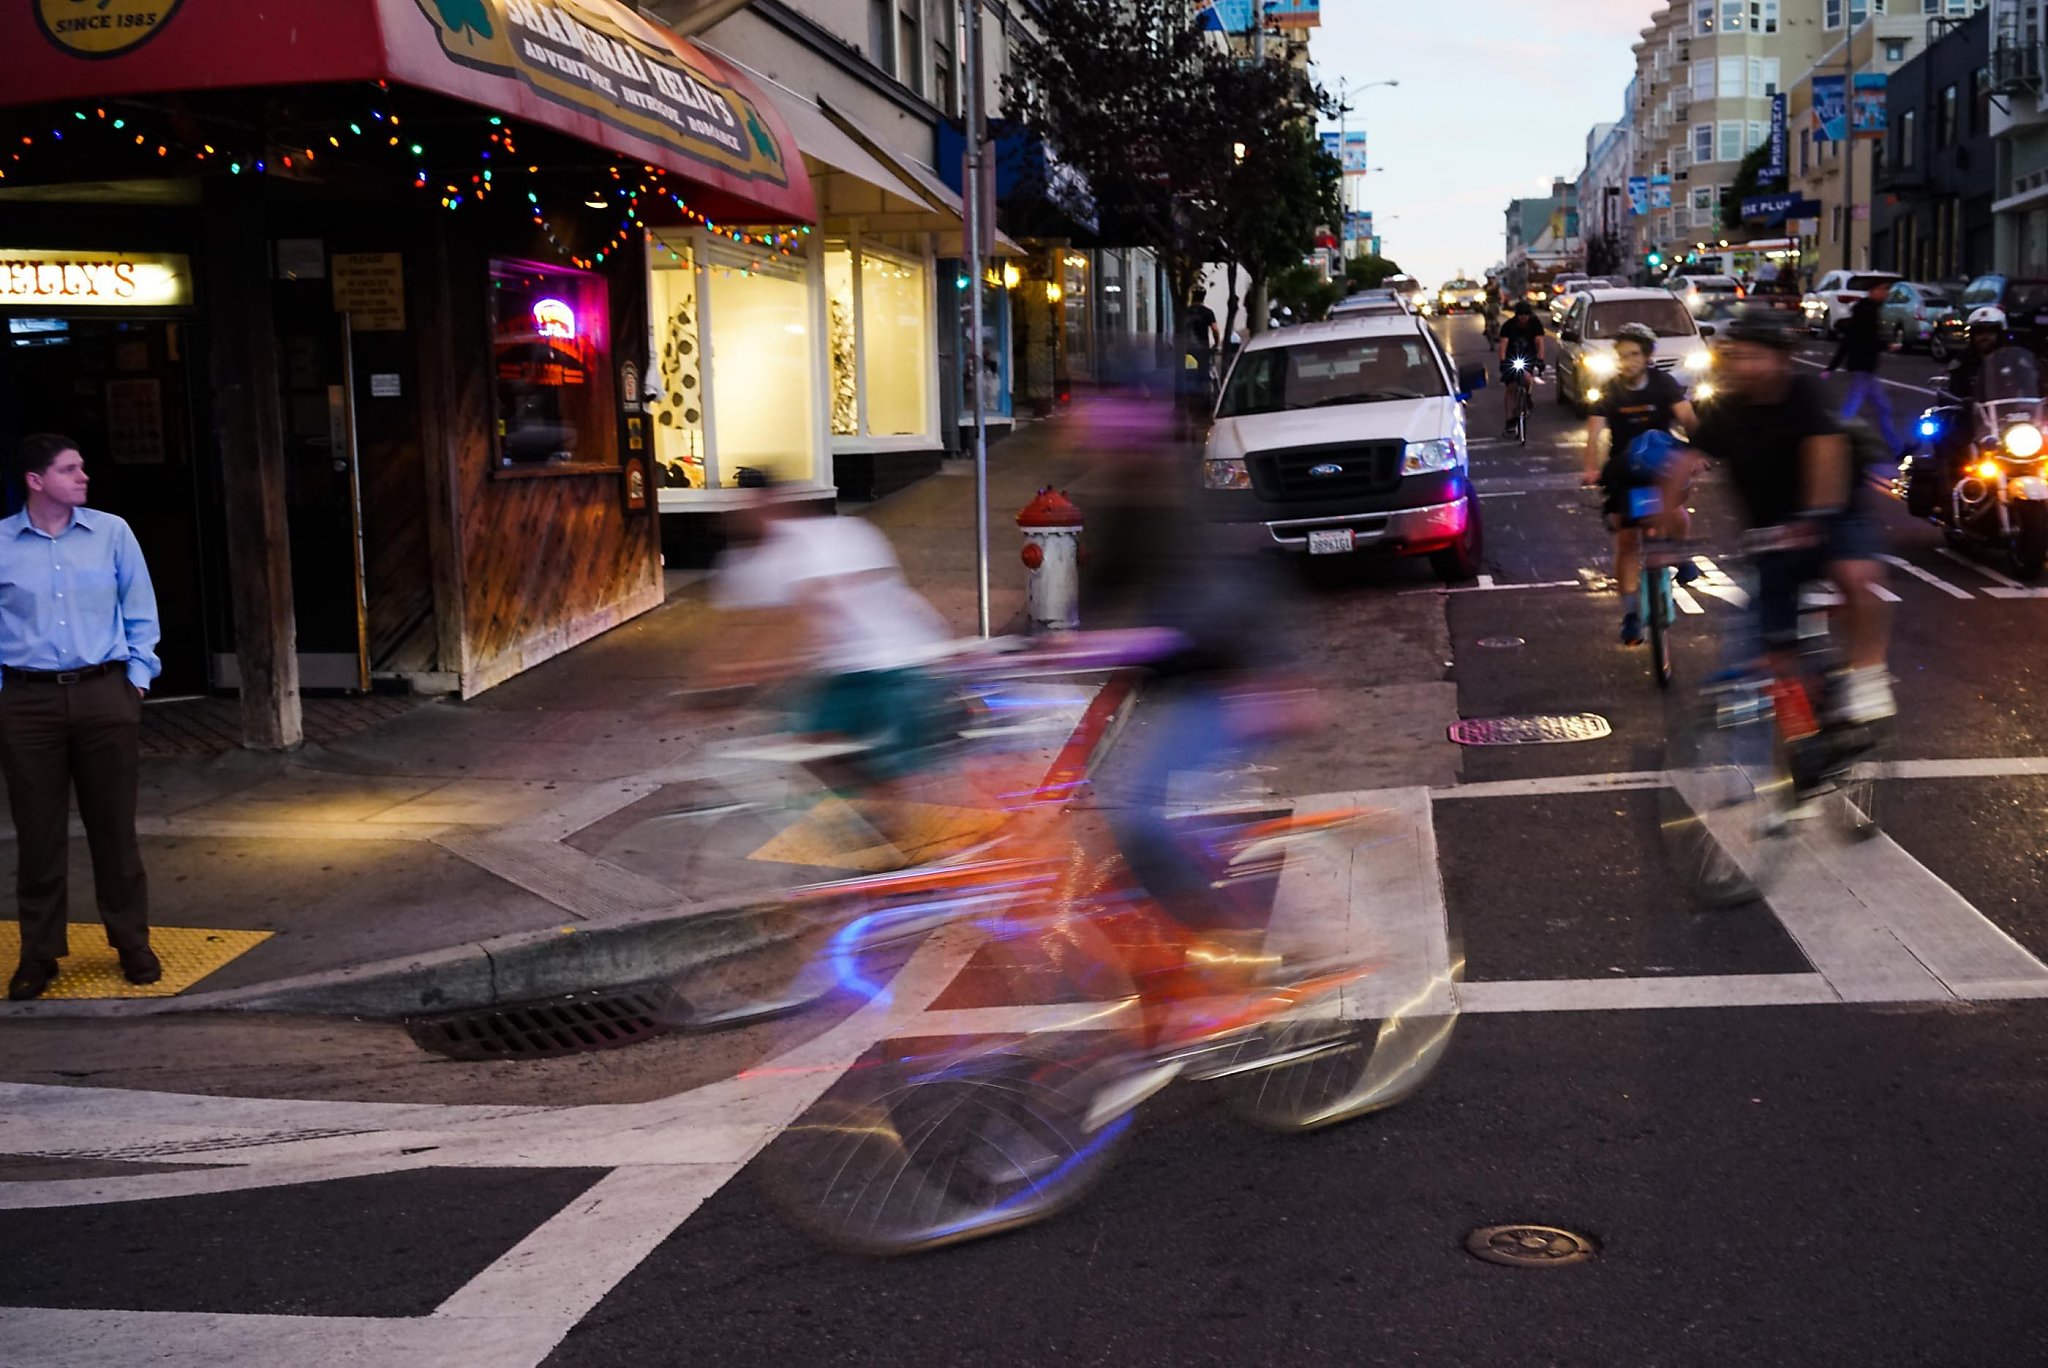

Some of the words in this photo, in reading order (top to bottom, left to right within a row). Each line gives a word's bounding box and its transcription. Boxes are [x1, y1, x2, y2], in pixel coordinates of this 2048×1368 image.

[56, 15, 111, 33] SINCE
[116, 13, 157, 28] 1985
[507, 0, 649, 84] SHANGHAI
[645, 58, 735, 127] KELLY'S
[523, 38, 618, 98] ADVENTURE,
[687, 116, 741, 151] ROMANCE
[0, 260, 135, 297] ELLY'S
